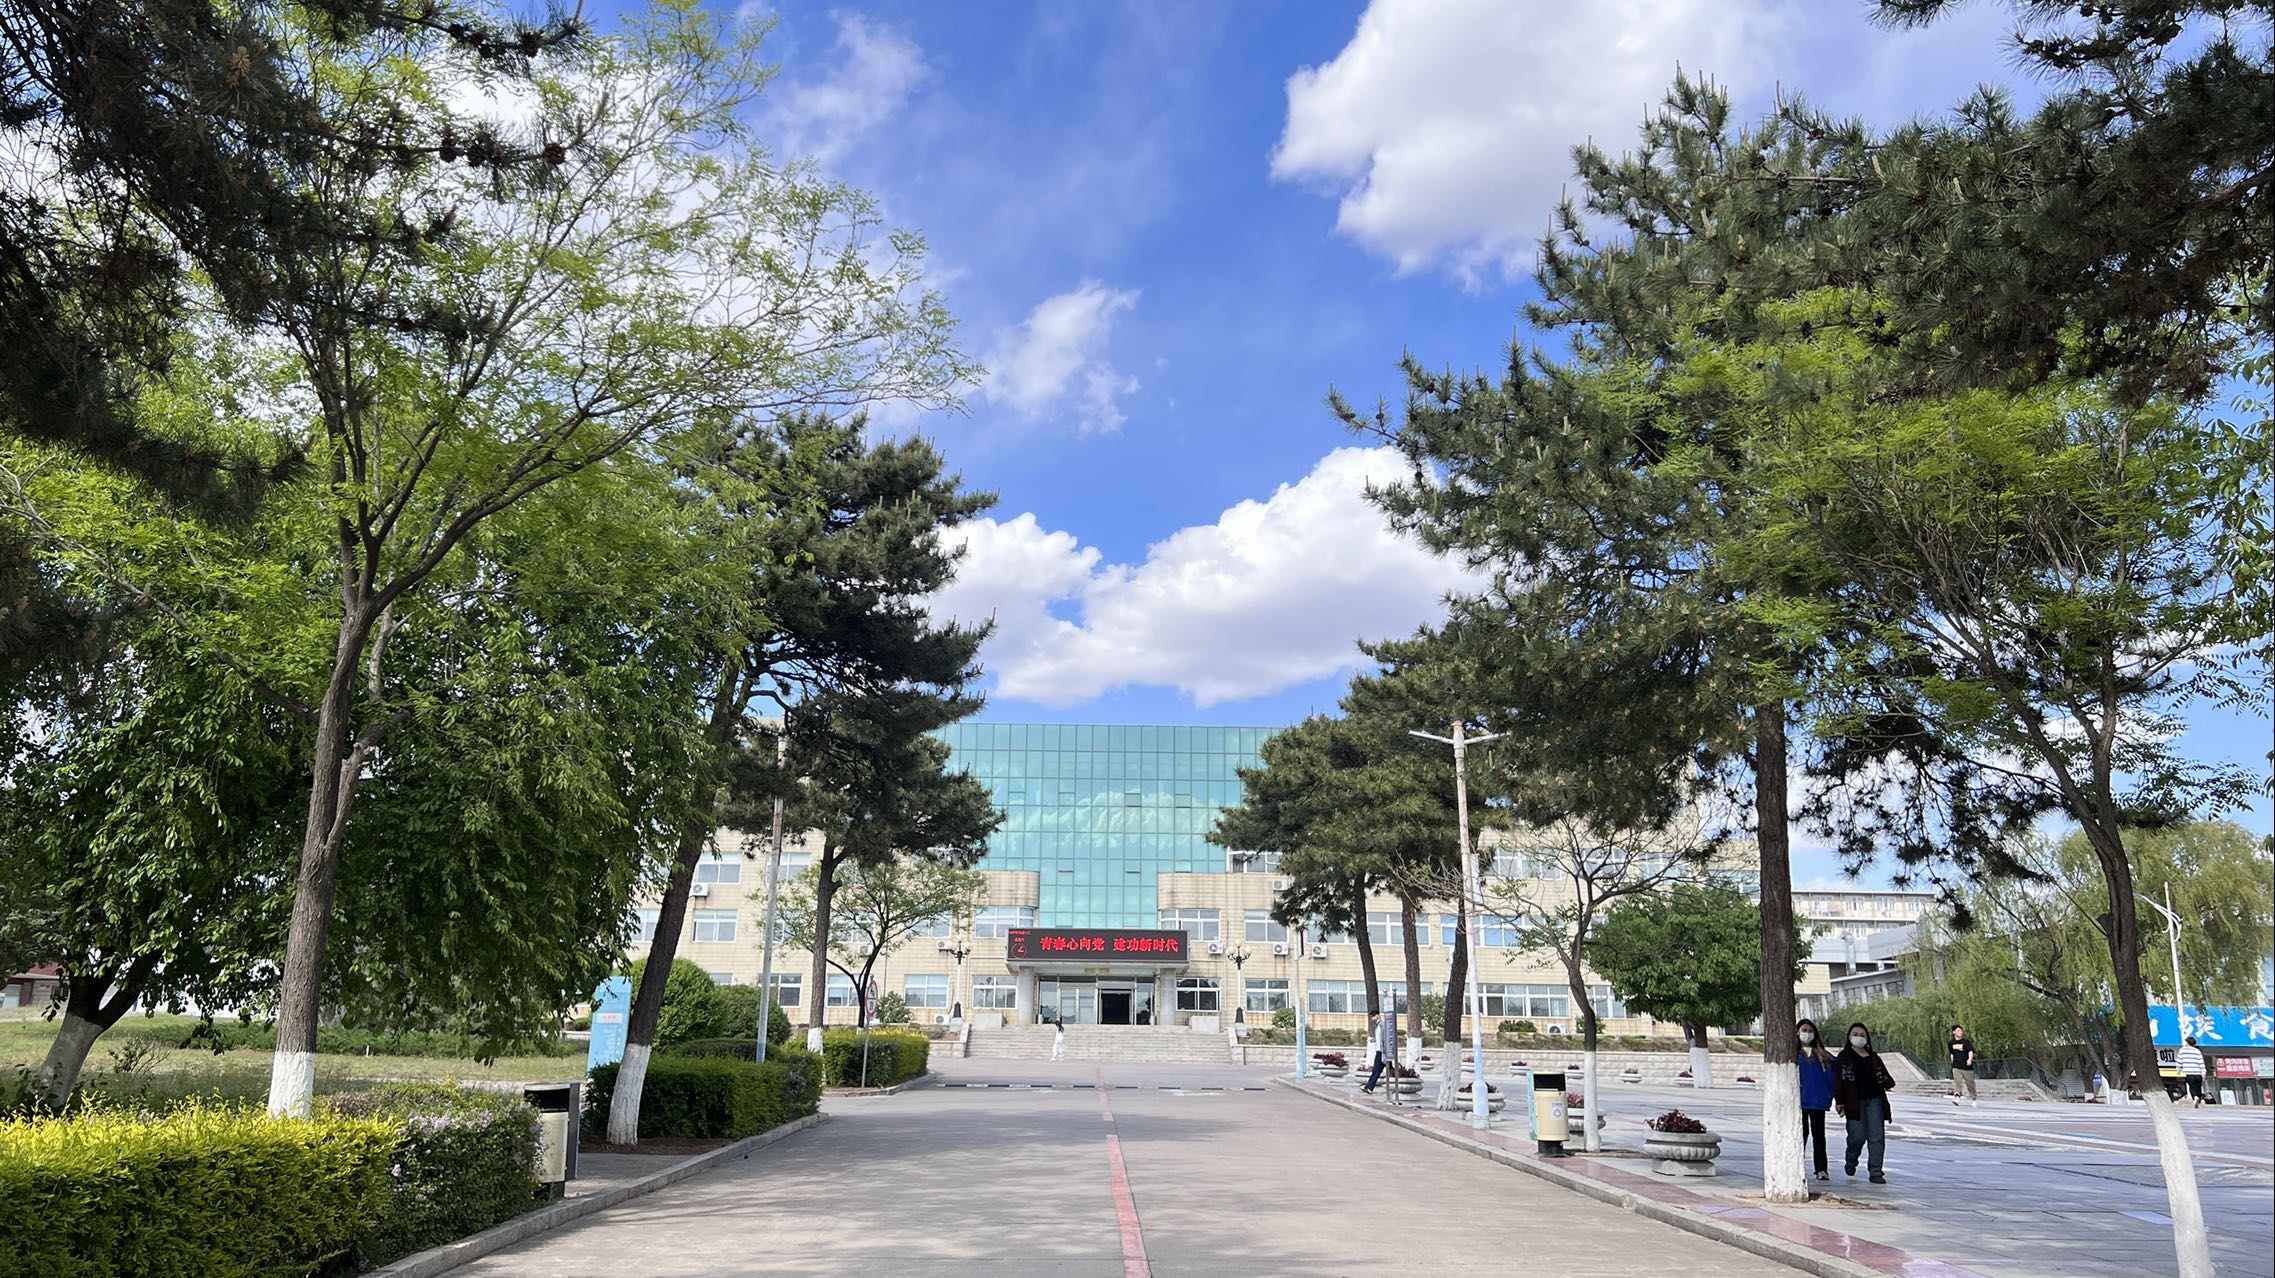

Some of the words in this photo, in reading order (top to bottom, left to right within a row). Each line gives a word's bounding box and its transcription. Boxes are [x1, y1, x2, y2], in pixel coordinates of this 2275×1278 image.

[1040, 936, 1104, 951] 青春心向党
[1113, 937, 1179, 952] 建功新时代
